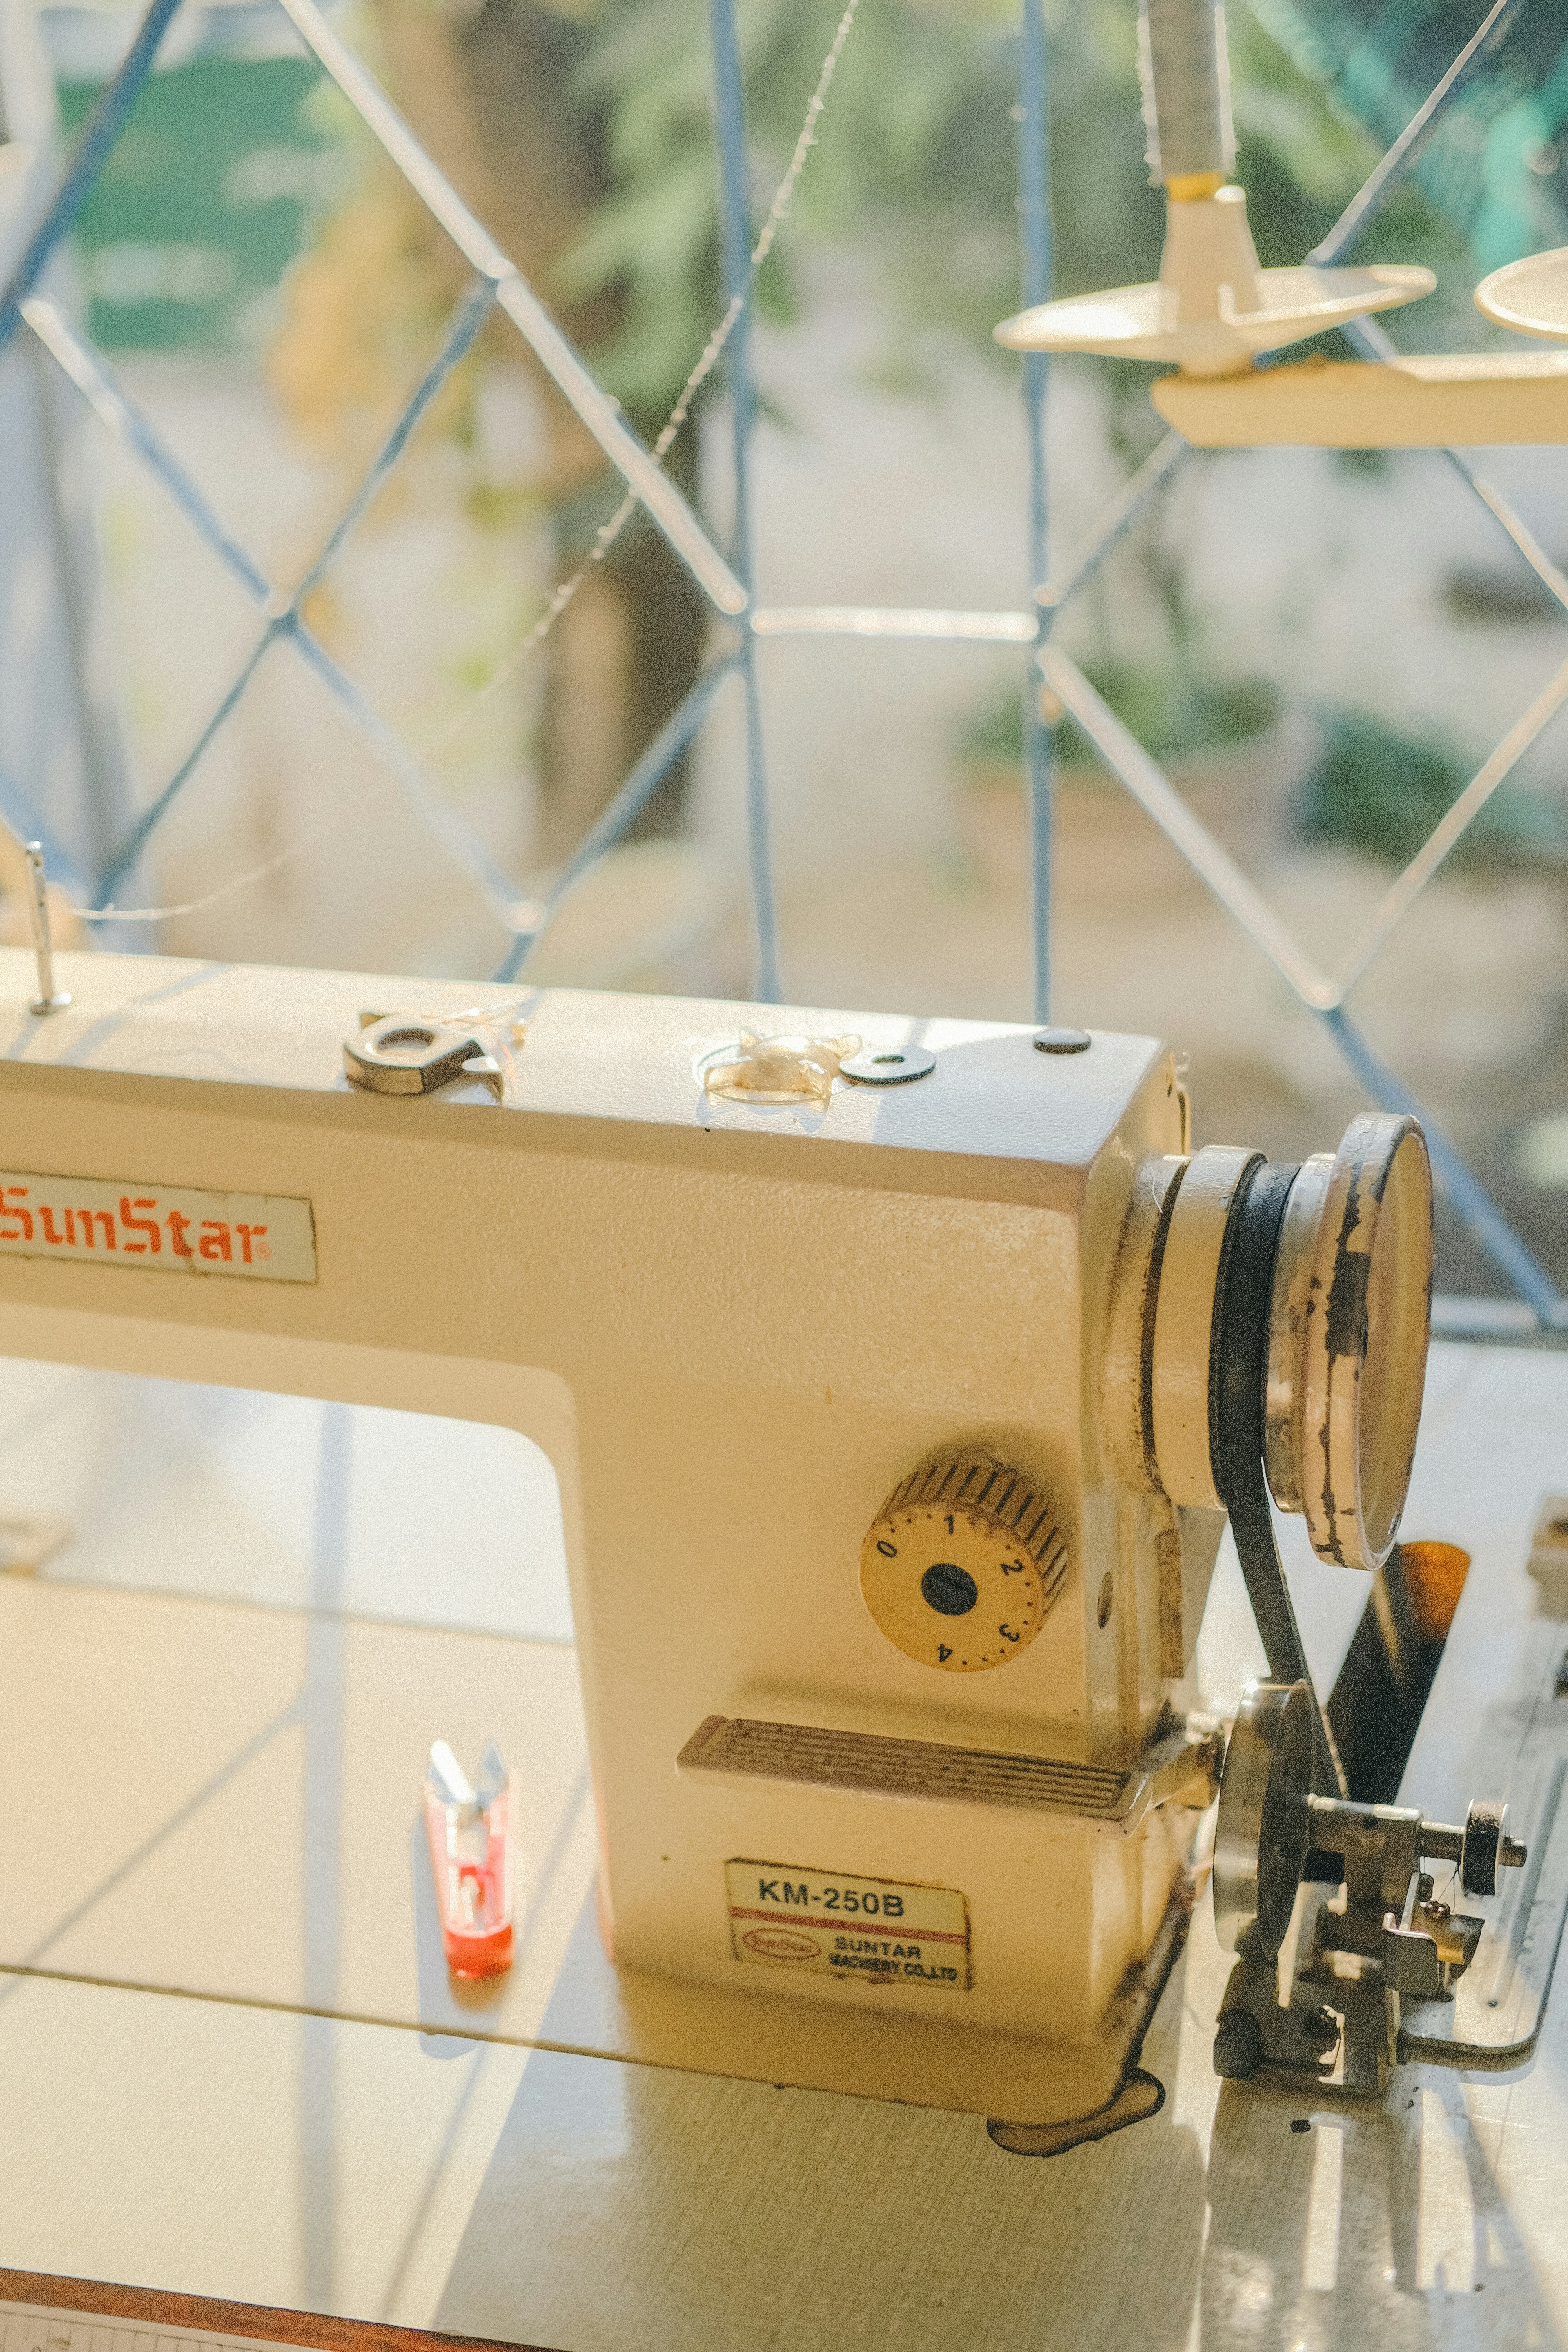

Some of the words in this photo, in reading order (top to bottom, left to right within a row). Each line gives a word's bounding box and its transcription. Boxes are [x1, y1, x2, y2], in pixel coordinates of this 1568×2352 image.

[944, 1514, 954, 1534] 1
[876, 1541, 897, 1558] 0
[1000, 1559, 1024, 1576] 2
[998, 1623, 1020, 1642] 3
[937, 1643, 953, 1662] 4
[758, 1878, 904, 1917] KM-250B
[835, 1936, 921, 1960] SUNTAR
